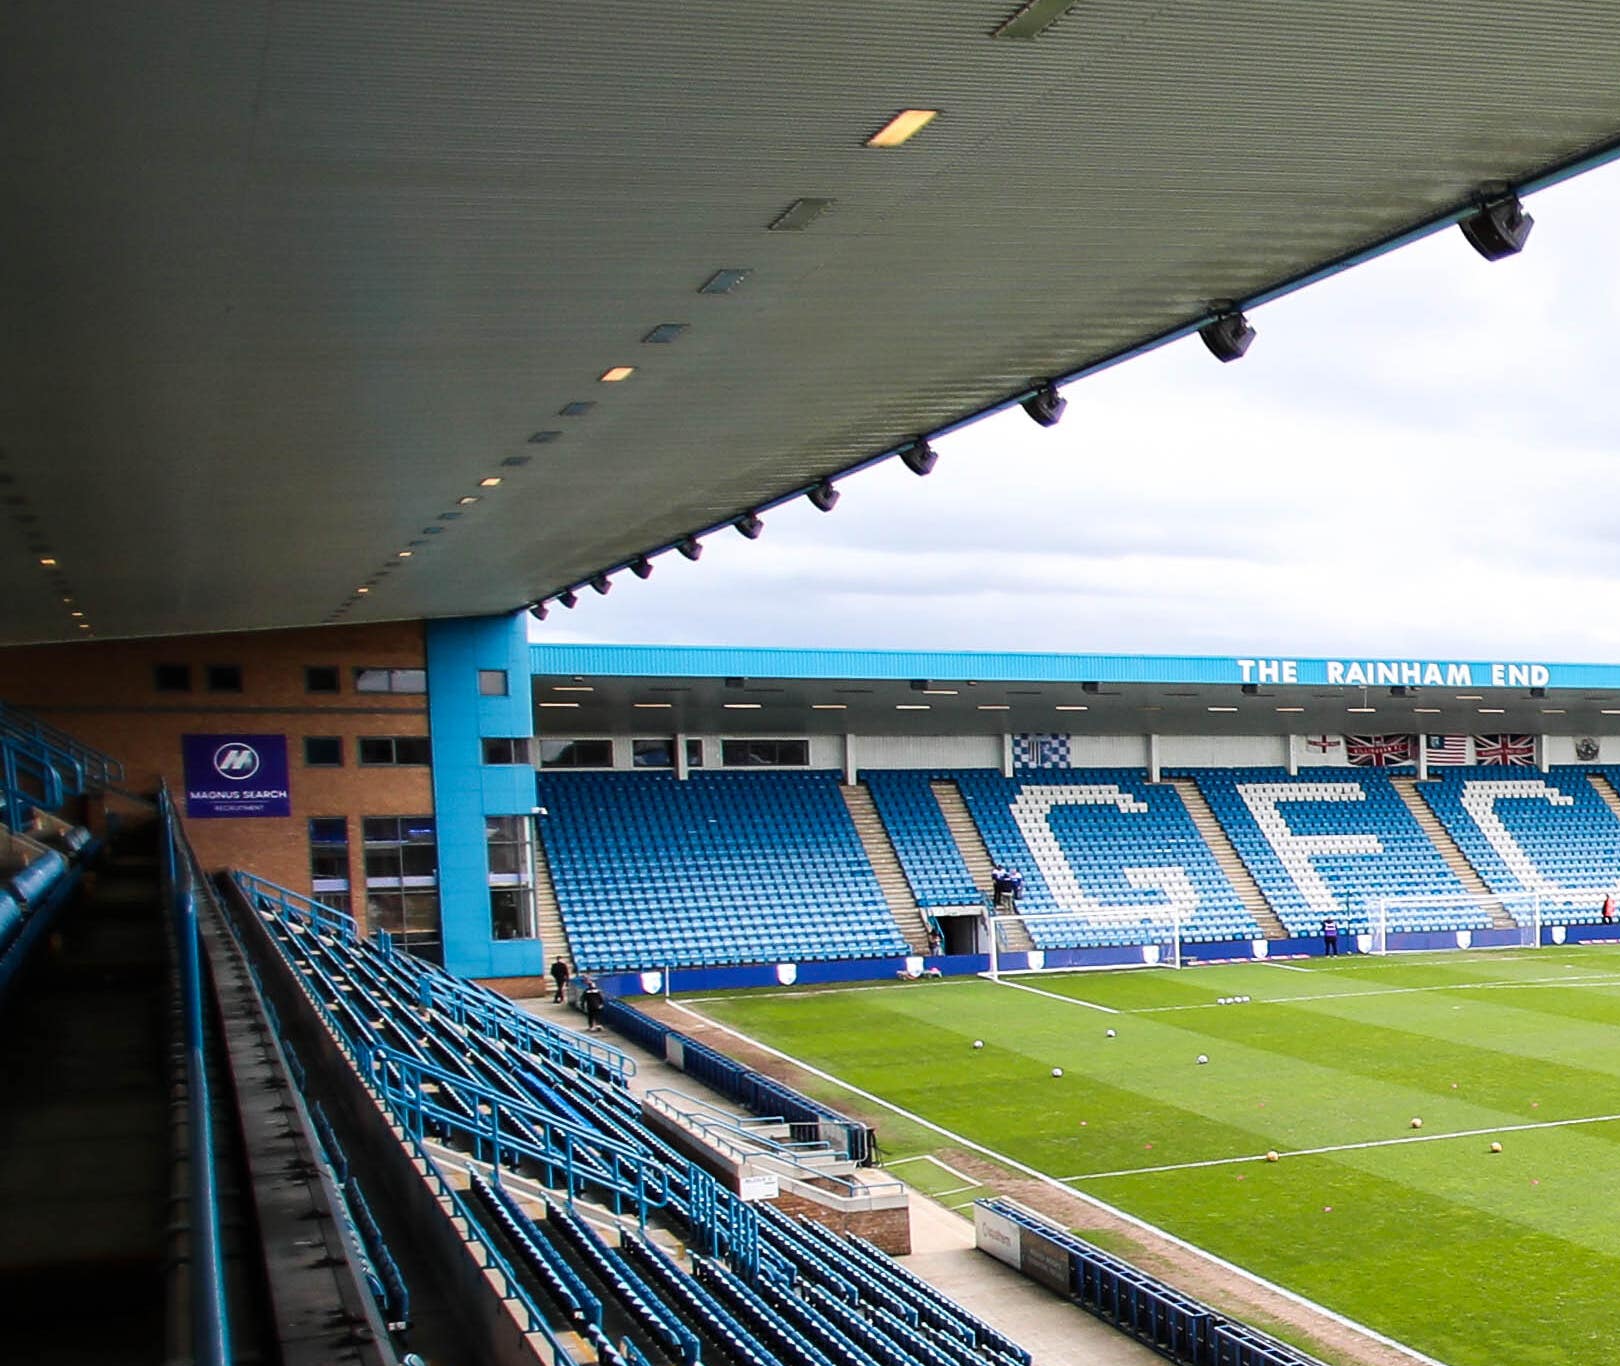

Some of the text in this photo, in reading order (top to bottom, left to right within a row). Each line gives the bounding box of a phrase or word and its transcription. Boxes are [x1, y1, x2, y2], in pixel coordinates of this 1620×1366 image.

[1237, 660, 1550, 686] THE RAINHAM END
[190, 790, 288, 799] MAGNUS SEARCH
